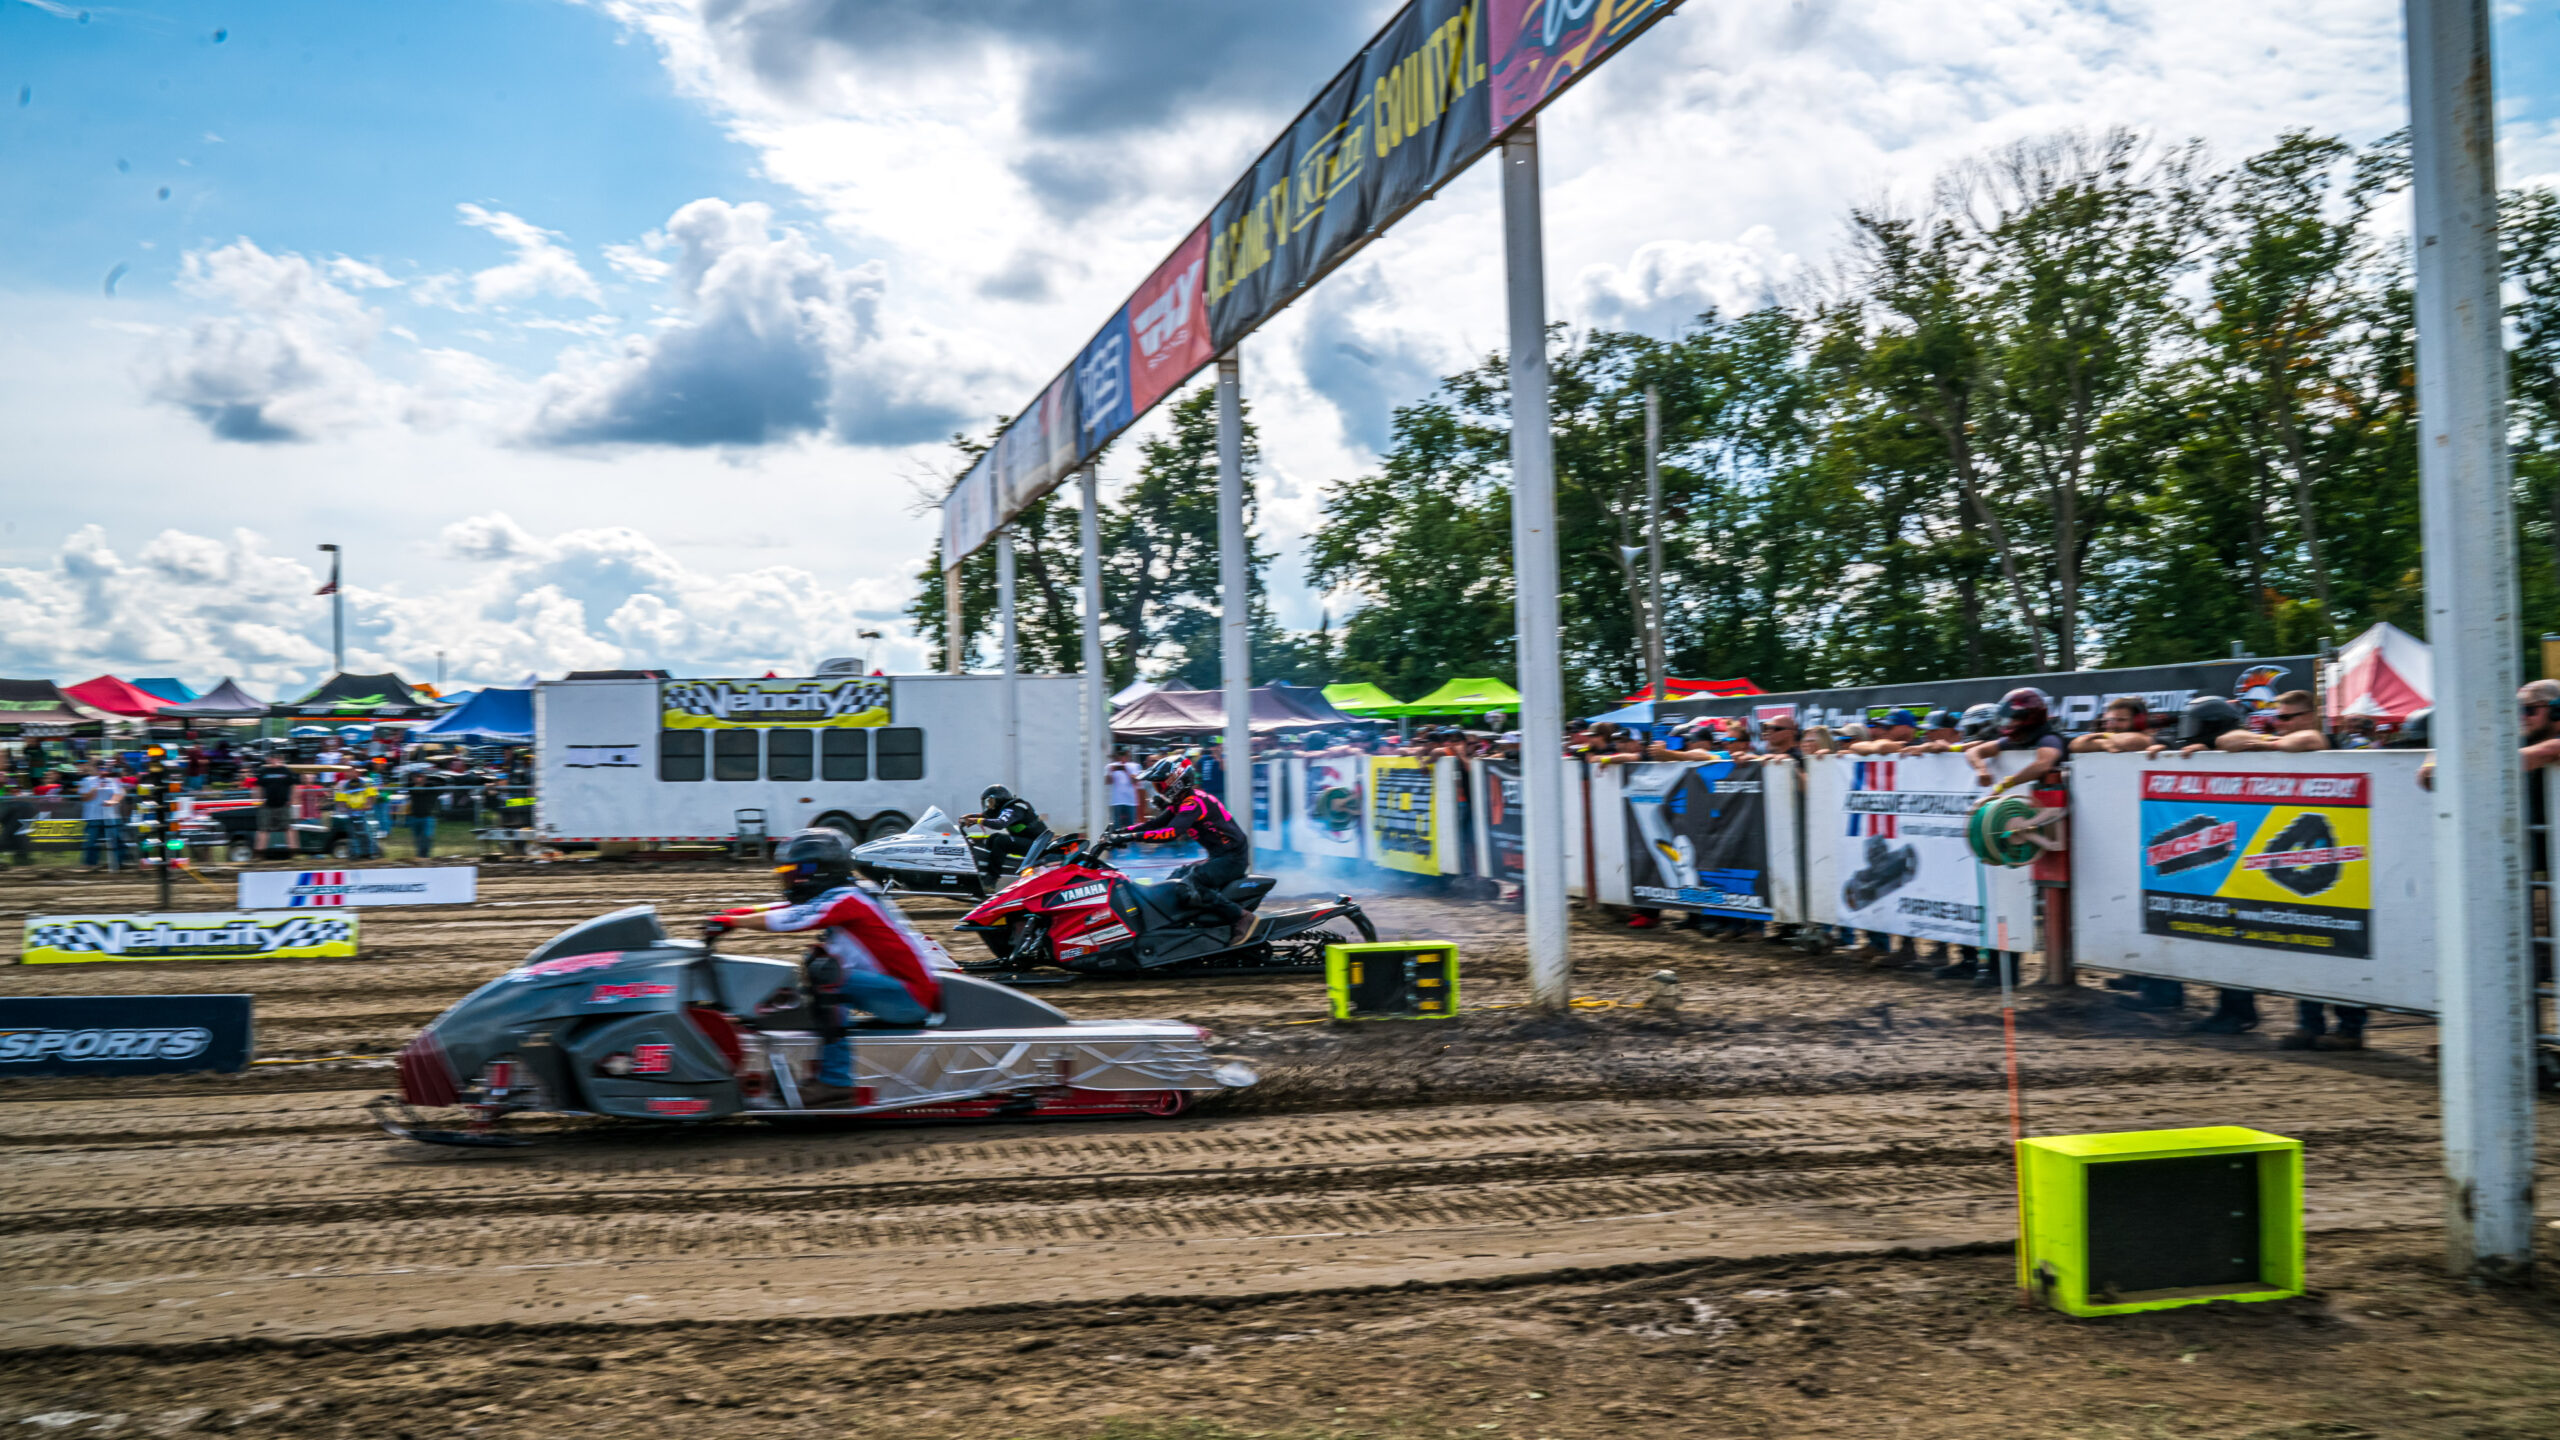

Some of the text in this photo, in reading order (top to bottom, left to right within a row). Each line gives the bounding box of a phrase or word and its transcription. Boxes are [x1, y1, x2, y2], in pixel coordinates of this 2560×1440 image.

[1133, 258, 1204, 357] FLY
[699, 682, 861, 718] Velocity
[2148, 775, 2178, 793] FOR
[2177, 776, 2205, 794] ALL
[2205, 777, 2244, 796] YOUR
[2247, 778, 2296, 797] TRACK
[1143, 827, 1177, 840] FXR
[1061, 883, 1107, 902] YAMAHA
[77, 918, 311, 955] Velocity
[0, 1029, 210, 1060] SPORTS
